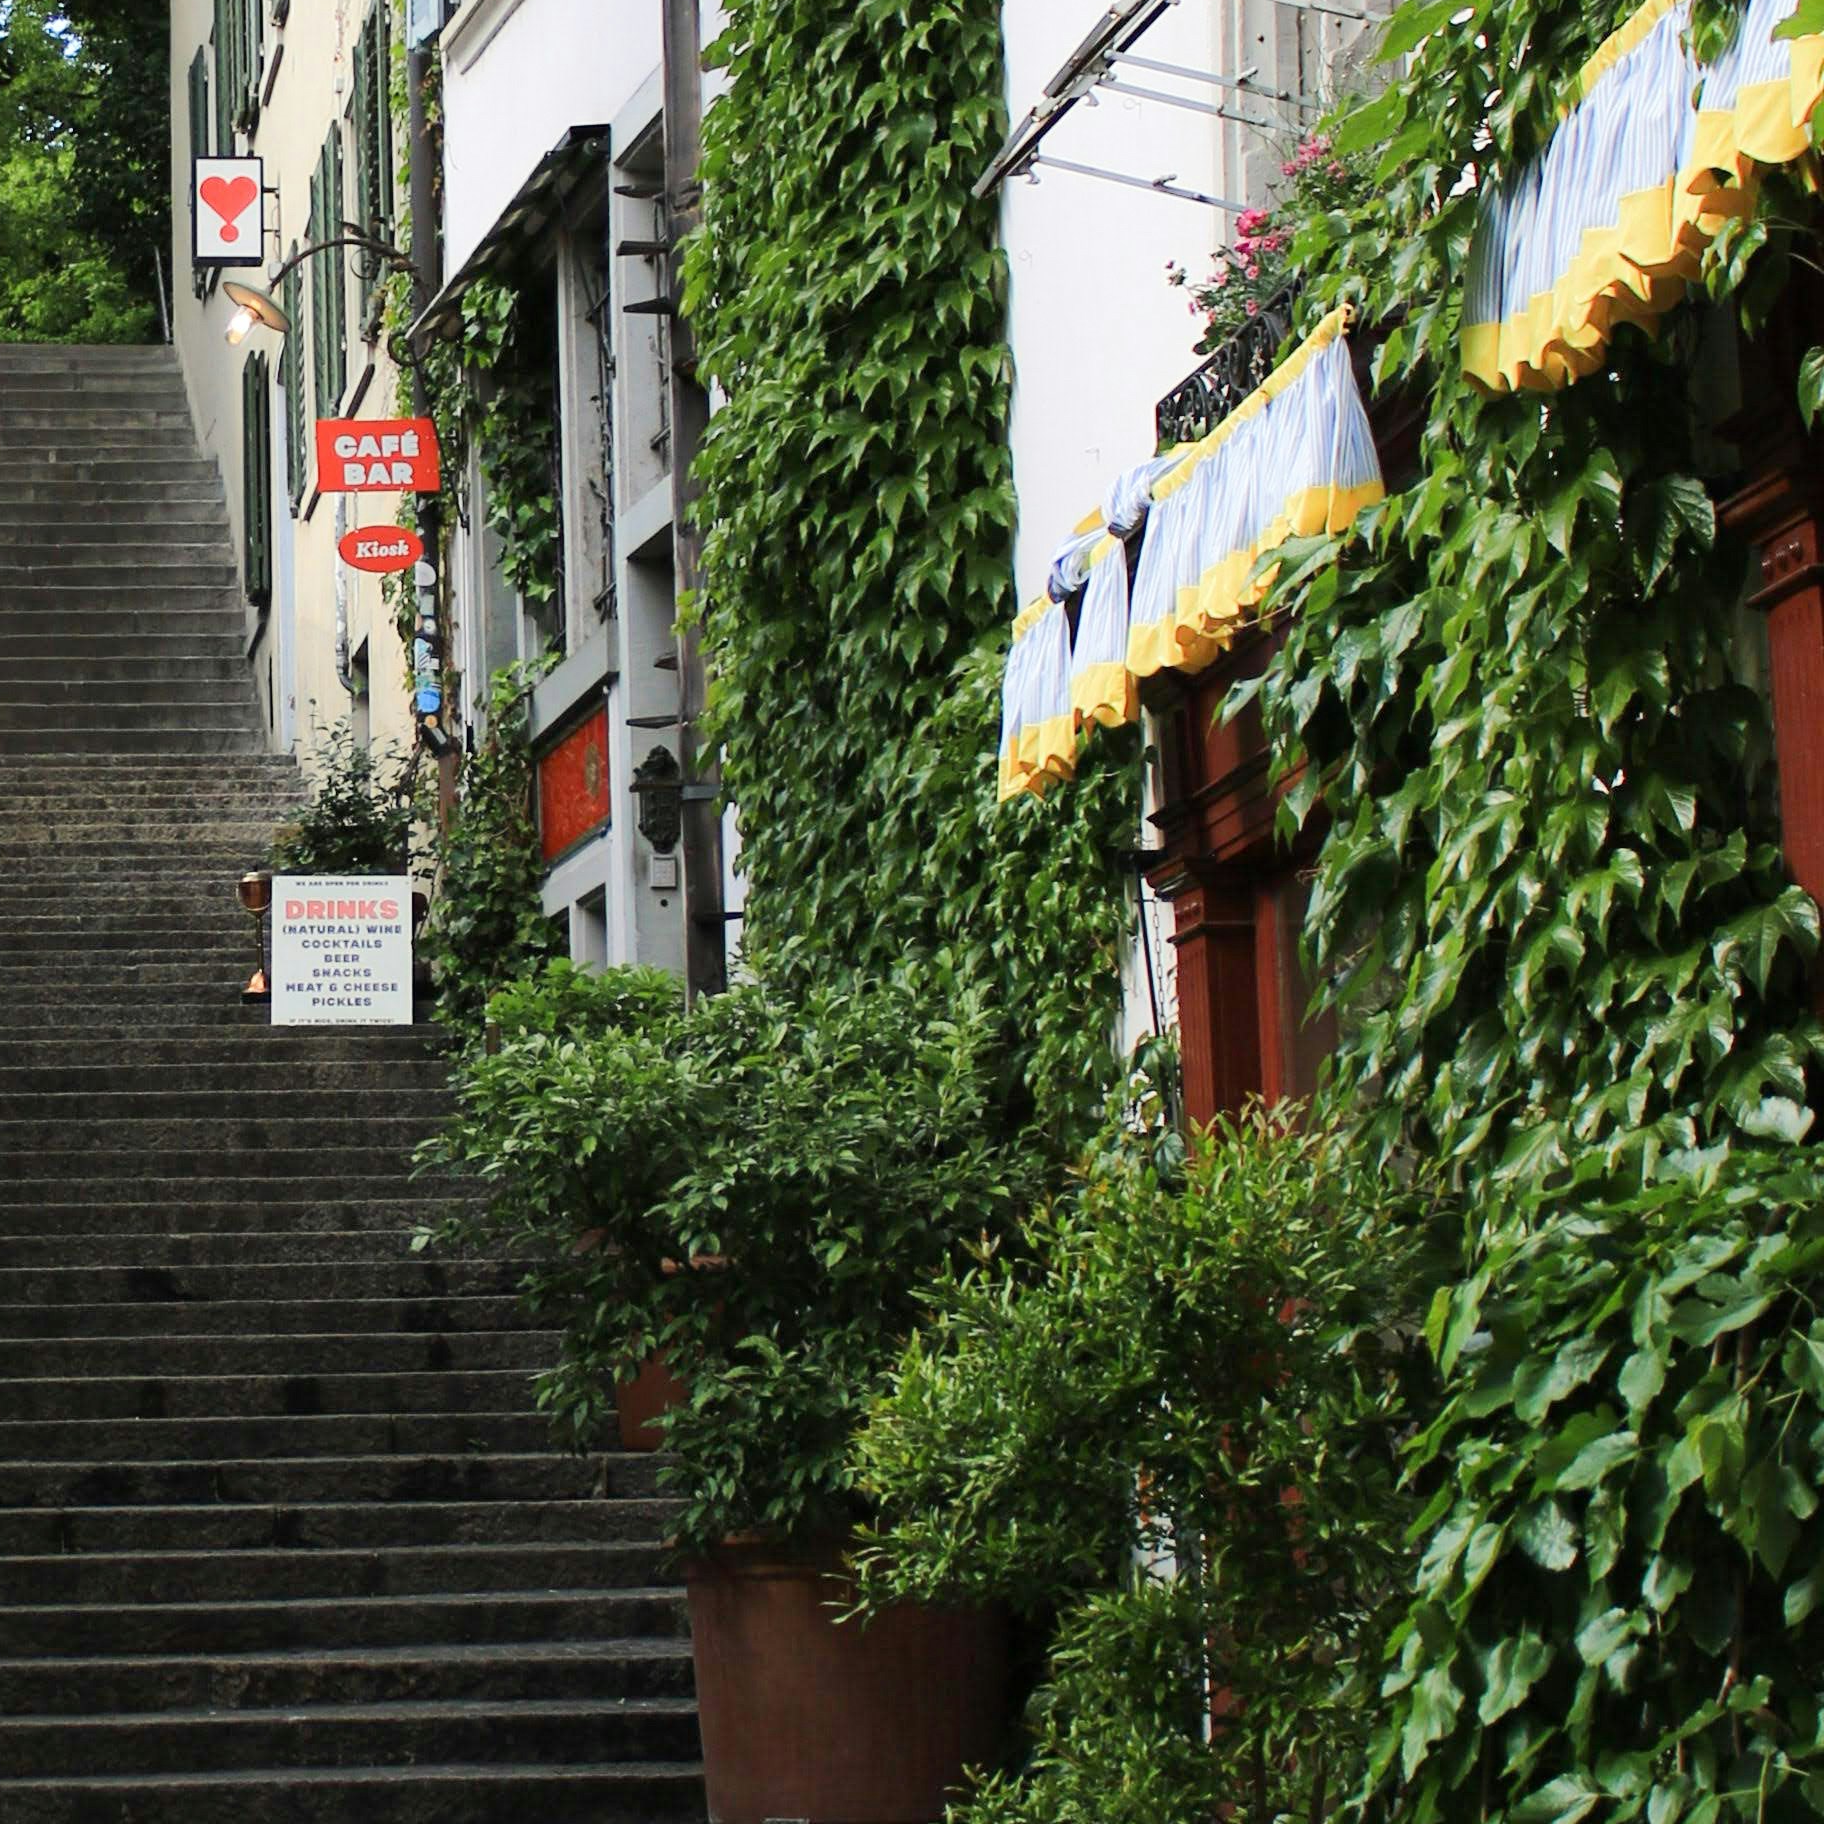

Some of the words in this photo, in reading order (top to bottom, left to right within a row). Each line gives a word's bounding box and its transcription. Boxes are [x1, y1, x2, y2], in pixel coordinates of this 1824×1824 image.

[334, 429, 419, 458] CAFÉ
[343, 462, 414, 486] BAR
[355, 539, 410, 559] Kiosk
[285, 900, 399, 920] DRINKS
[282, 925, 360, 934] (NATURAL)
[366, 925, 402, 934] WINE
[301, 939, 383, 949] COCKTAILS
[324, 954, 360, 963] BEER
[312, 968, 372, 978] SNACKS
[286, 983, 323, 992] MEAT
[343, 983, 399, 992] CHEESE
[312, 997, 373, 1007] PICKLES
